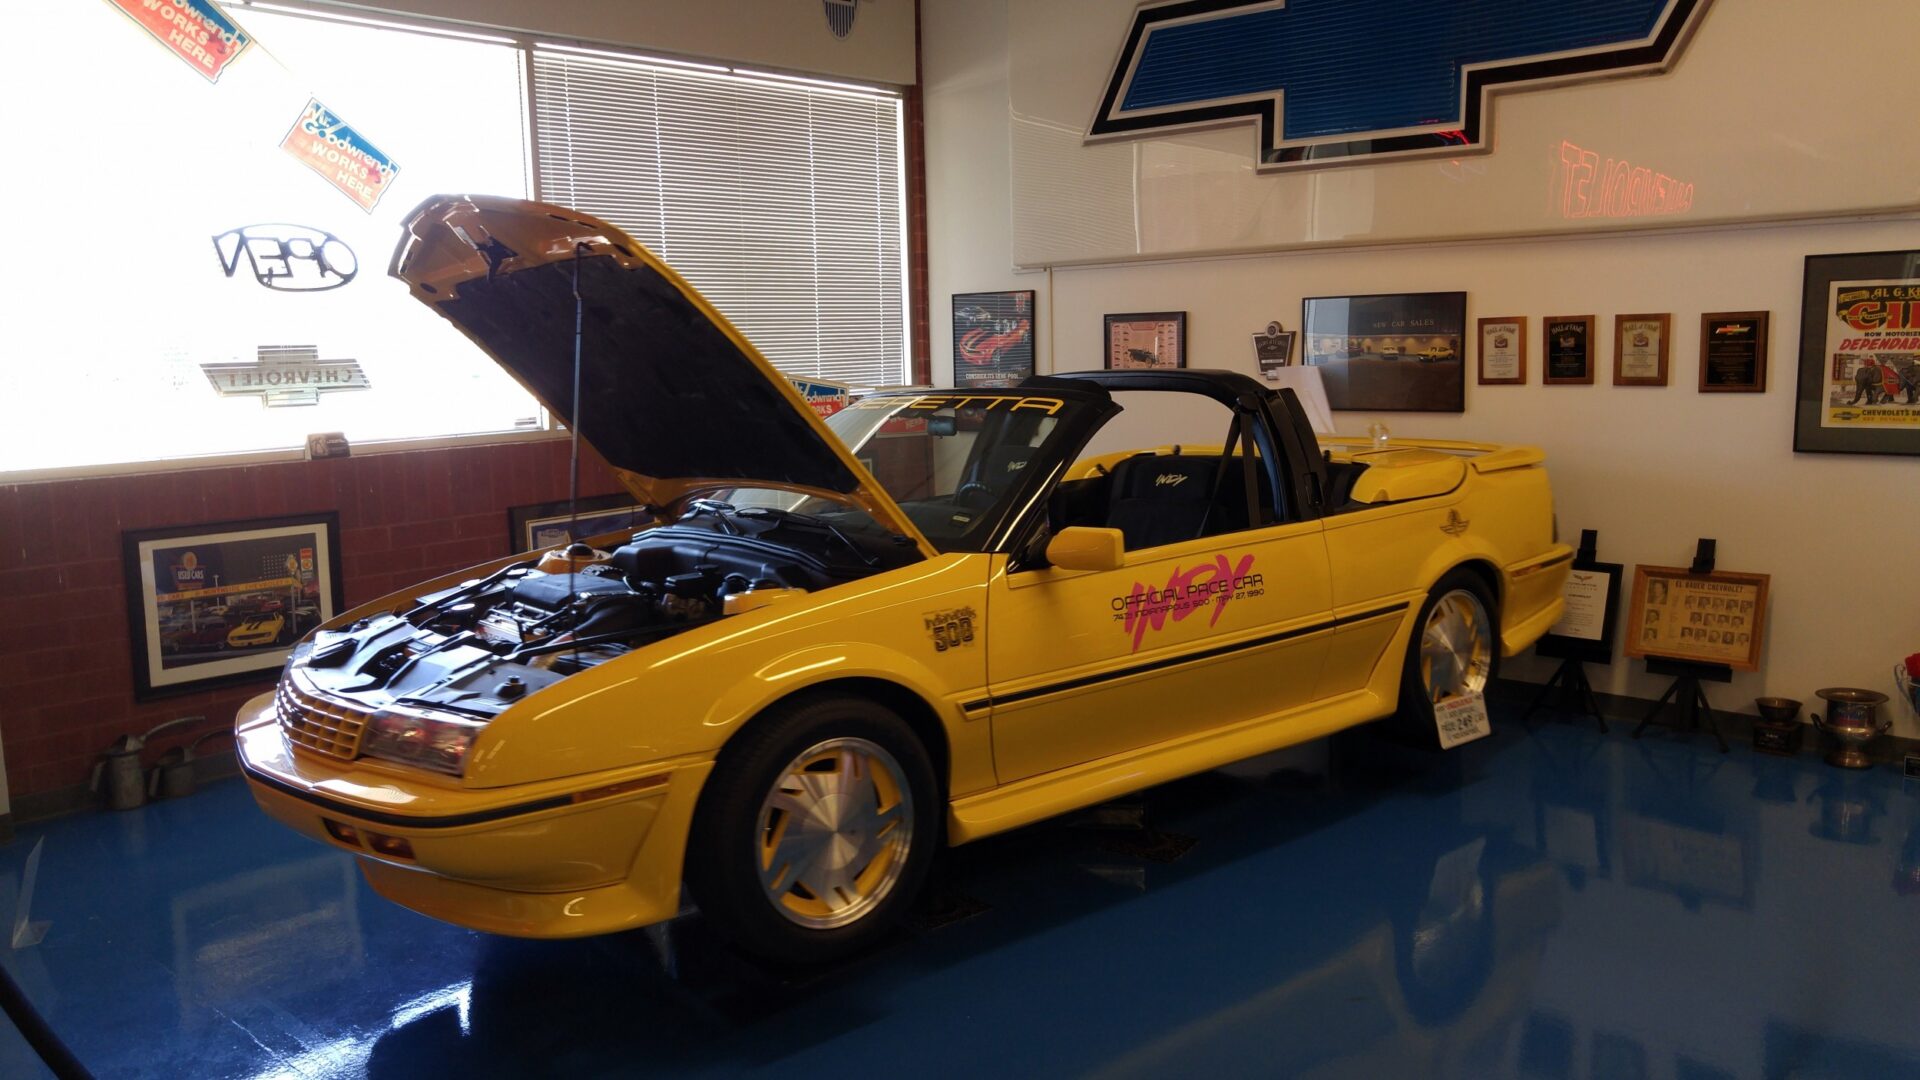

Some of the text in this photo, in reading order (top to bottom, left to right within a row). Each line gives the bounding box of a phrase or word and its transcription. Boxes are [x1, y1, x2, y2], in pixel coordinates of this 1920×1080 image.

[143, 0, 210, 45] WORKS
[168, 29, 216, 68] HERE
[301, 117, 397, 180] Goodwrench
[311, 141, 369, 180] WORKS
[336, 170, 374, 199] HERE
[1410, 318, 1434, 327] SALES
[1551, 324, 1564, 334] HALL
[1840, 338, 1920, 351] DEPENDAB
[1156, 473, 1188, 487] INDY
[1112, 573, 1264, 611] OFFICIAL PACE CAR
[1124, 553, 1255, 655] INDY
[1247, 588, 1265, 598] 1990
[933, 616, 974, 652] 500
